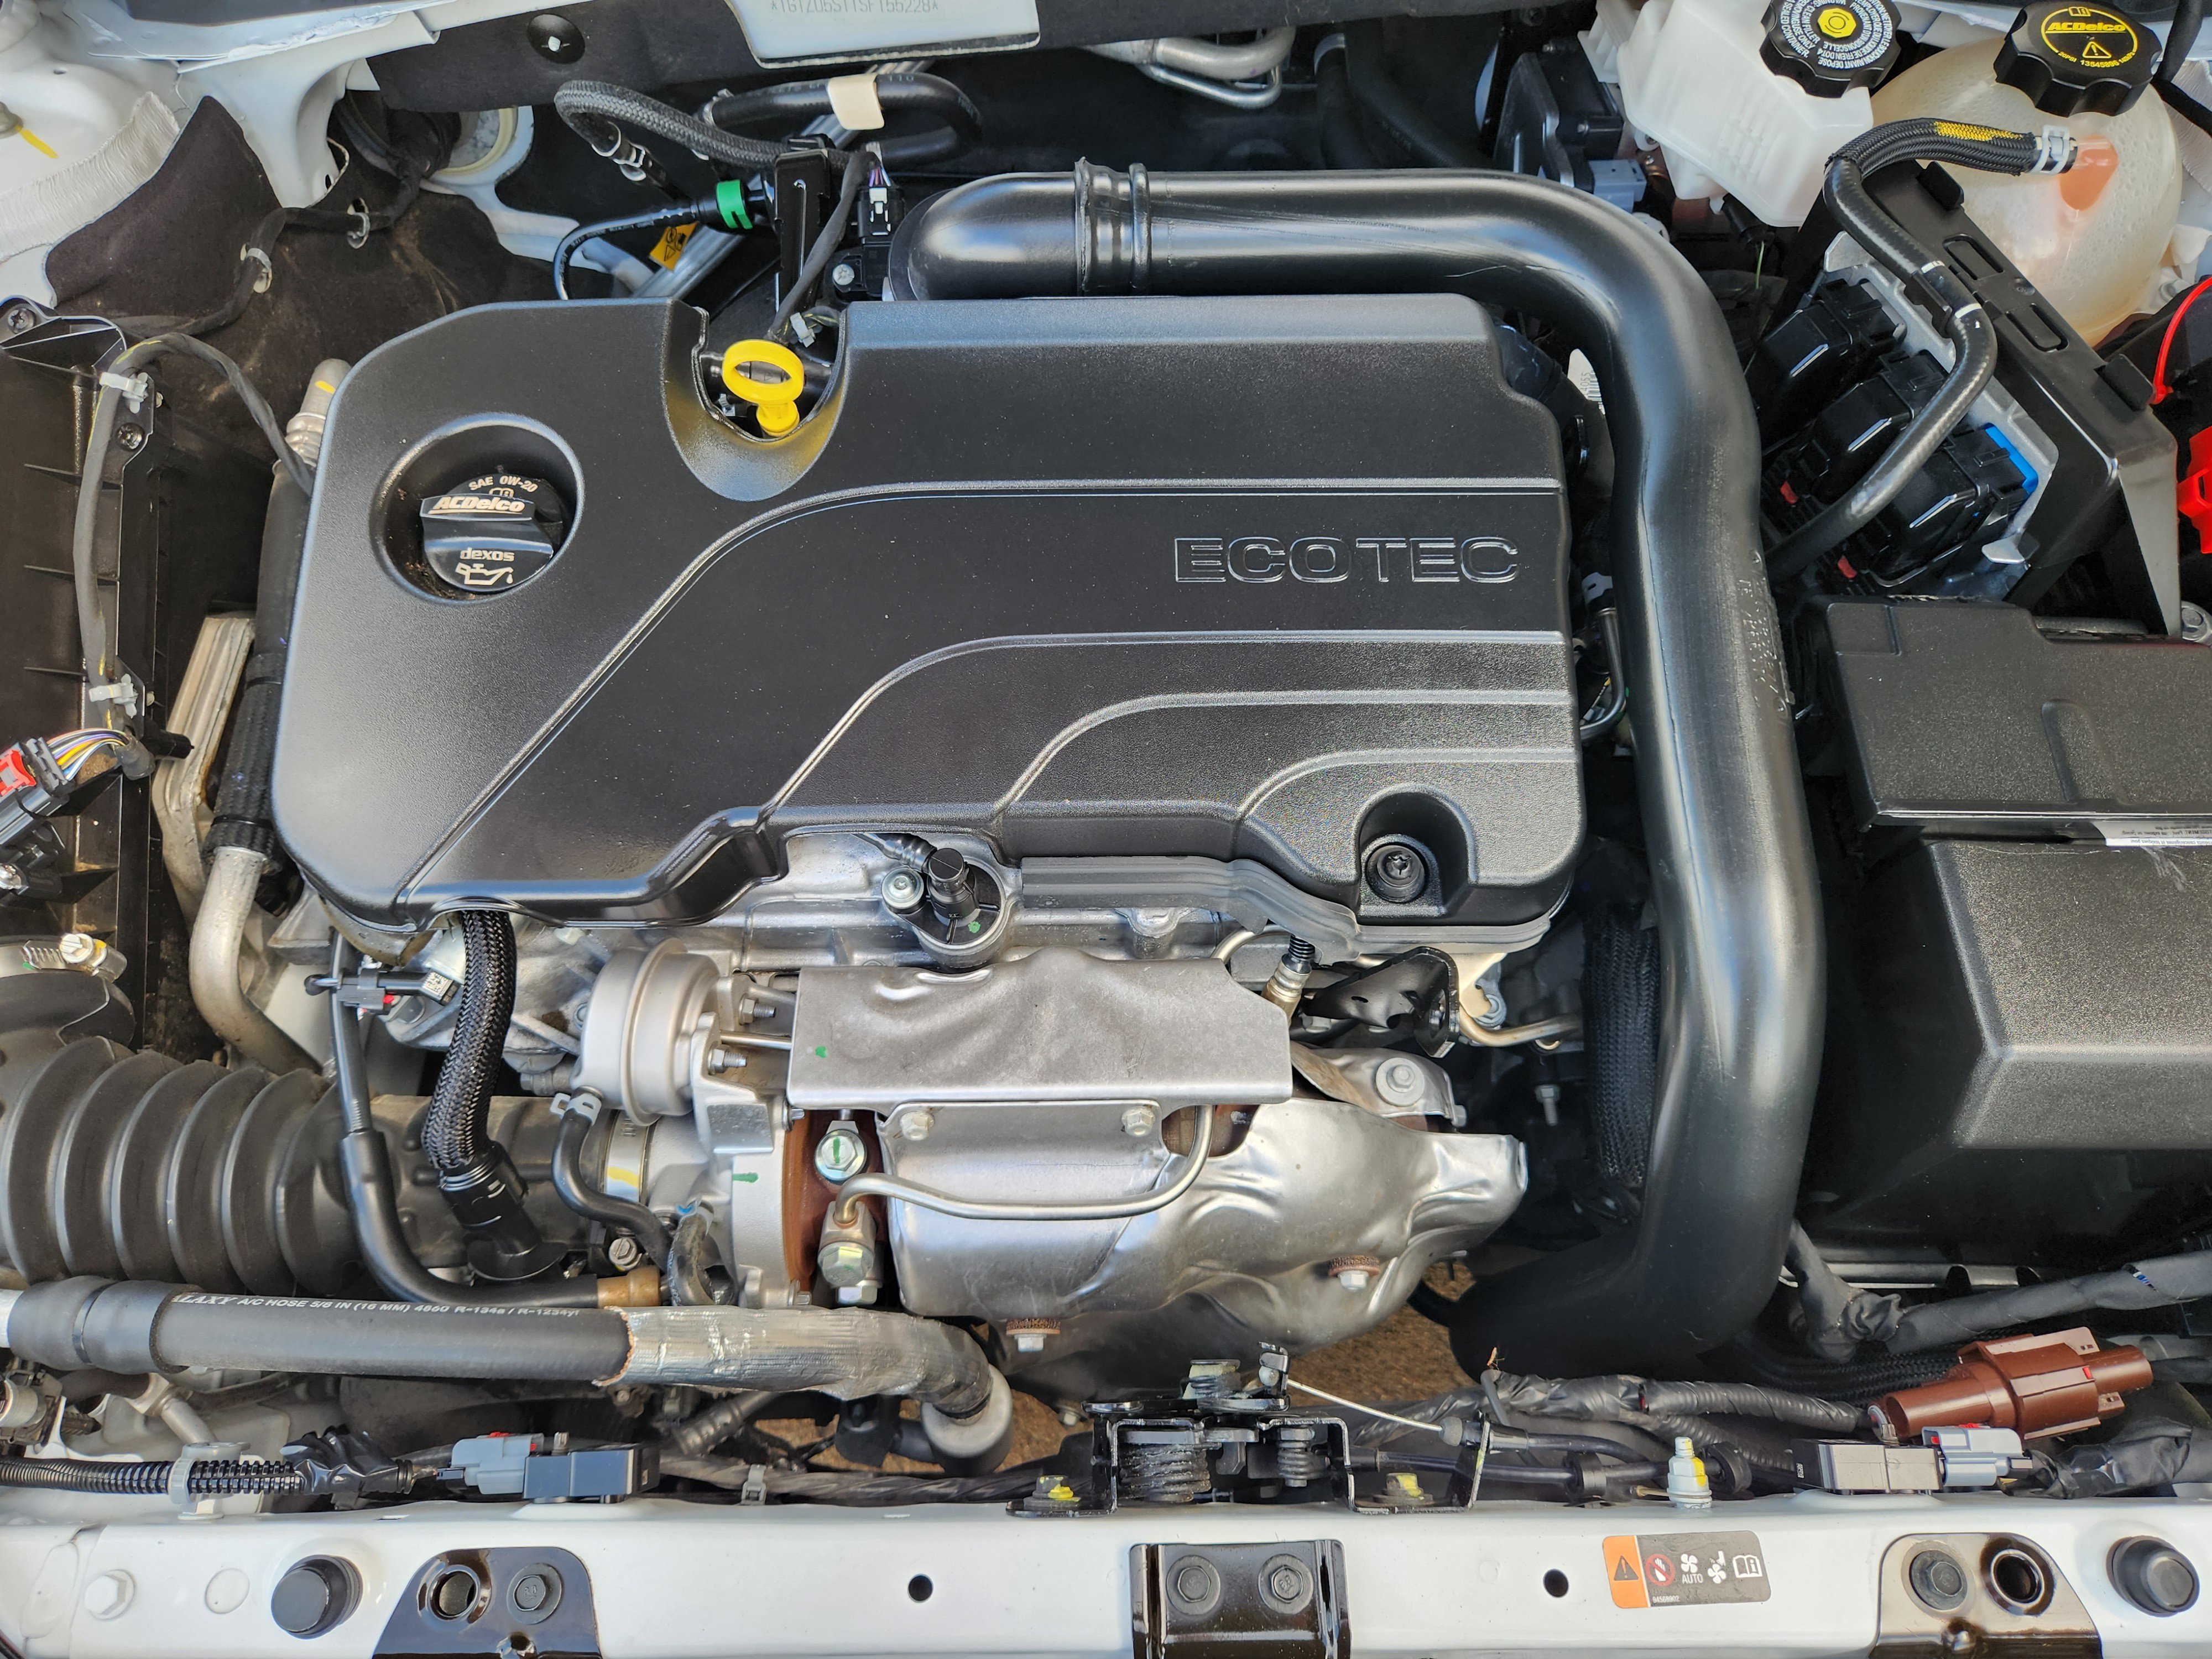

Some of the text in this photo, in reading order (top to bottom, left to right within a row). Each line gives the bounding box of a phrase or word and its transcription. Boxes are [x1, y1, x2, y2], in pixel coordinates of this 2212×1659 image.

[1781, 2, 1793, 24] SEALED
[1802, 5, 1815, 24] CLEAN
[1802, 24, 1821, 44] FILLER
[2047, 22, 2126, 32] ACDelco
[1791, 24, 1804, 36] USE
[1798, 34, 1816, 50] ONLY
[1844, 58, 1865, 69] AVANT
[468, 475, 539, 492] SAE 0W-20
[432, 495, 525, 513] ACDelco
[459, 547, 515, 562] dexos
[1174, 536, 1519, 583] ECOTEC
[265, 1300, 308, 1308] HOSE
[310, 1301, 333, 1309] 5/8
[335, 1301, 353, 1310] IN
[353, 1302, 378, 1311] (16
[379, 1303, 411, 1313] MM)
[1682, 1573, 1704, 1584] AUTO
